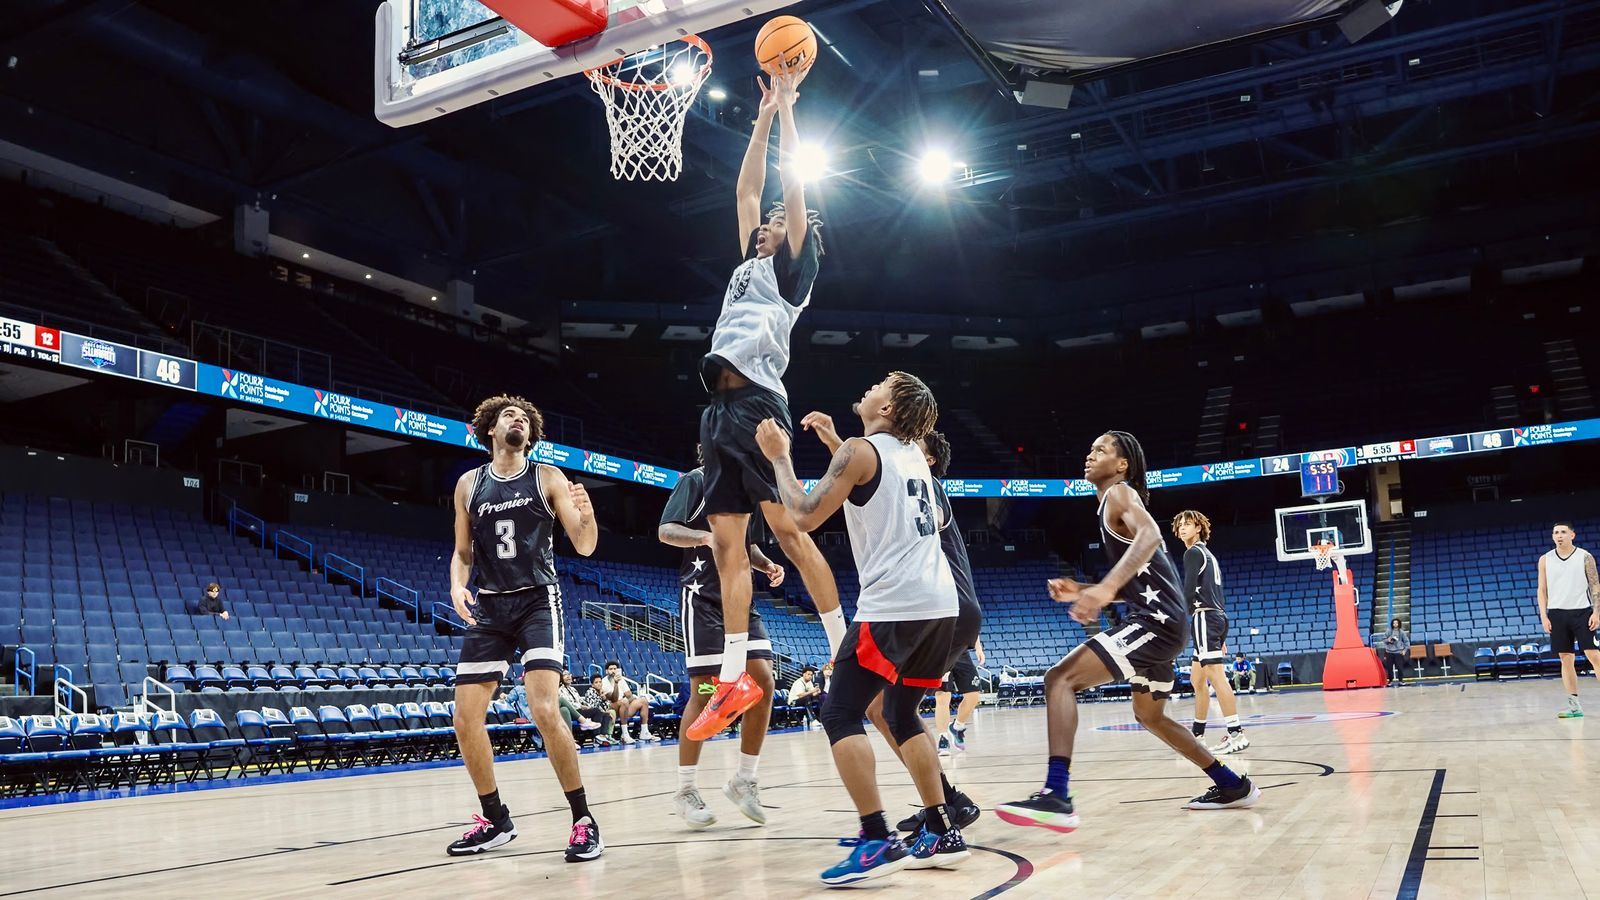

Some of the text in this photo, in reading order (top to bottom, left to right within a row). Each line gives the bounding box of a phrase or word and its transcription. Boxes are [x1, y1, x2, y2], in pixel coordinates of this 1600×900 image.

[41, 332, 54, 346] 12
[156, 358, 180, 384] 46
[240, 383, 264, 398] POINTS
[330, 402, 350, 416] POINTS
[409, 420, 426, 432] POINTS
[1483, 433, 1502, 448] 46
[1531, 432, 1553, 440] POINTS
[1372, 445, 1392, 455] 5:55
[1272, 458, 1290, 472] 24
[1310, 463, 1334, 475] 5:55
[1316, 474, 1332, 490] 11
[478, 496, 533, 517] Premier
[906, 478, 936, 536] 3
[495, 520, 517, 559] 3
